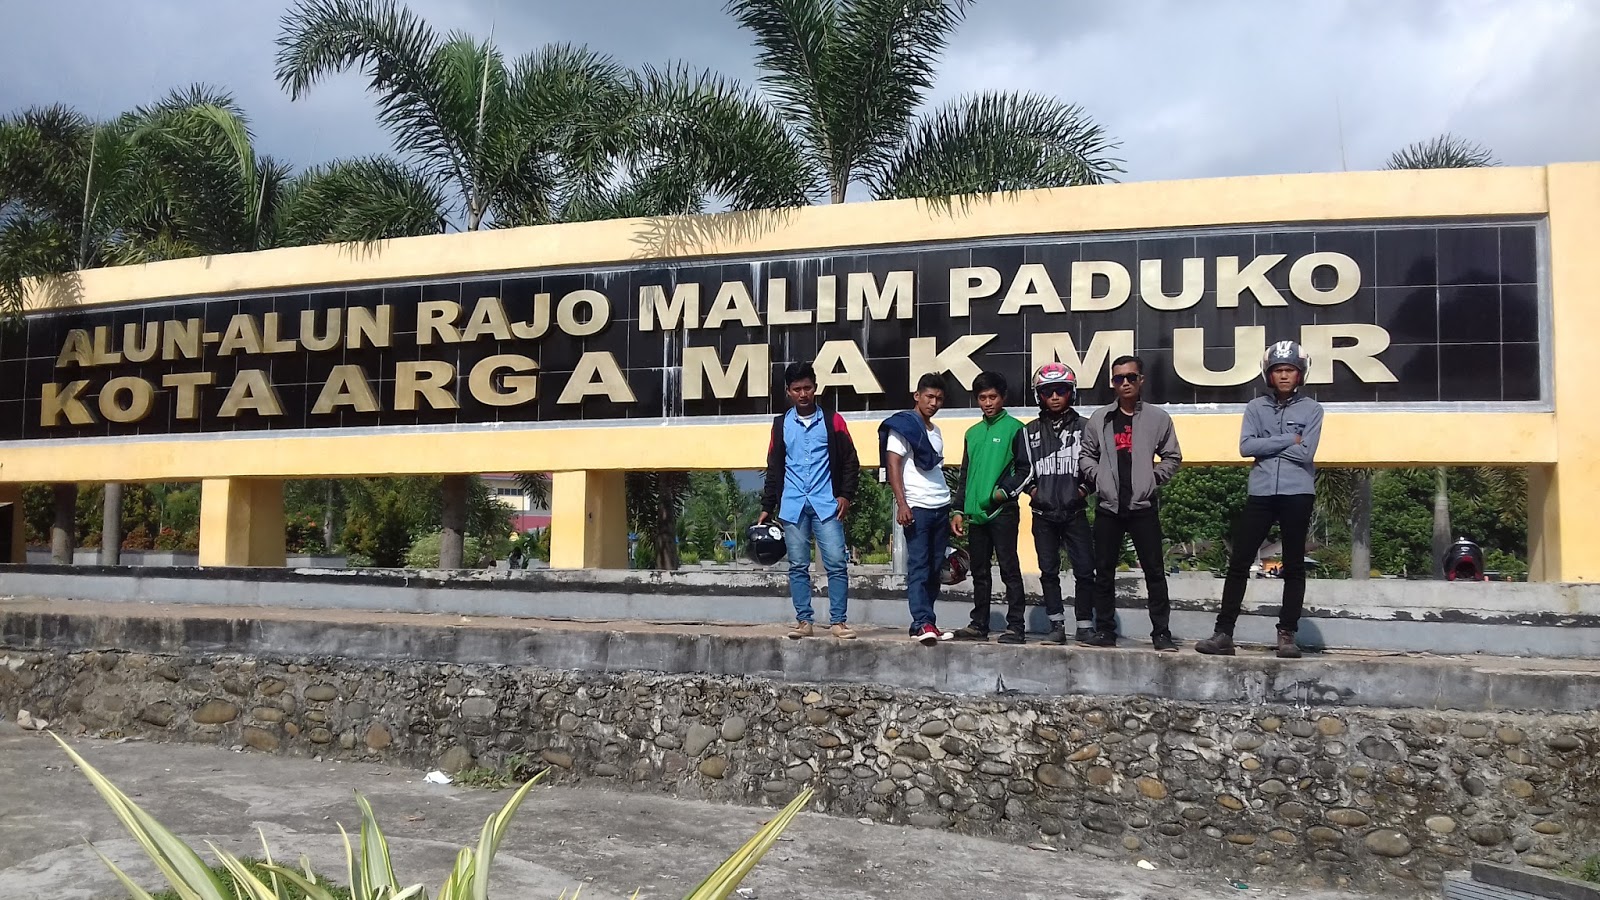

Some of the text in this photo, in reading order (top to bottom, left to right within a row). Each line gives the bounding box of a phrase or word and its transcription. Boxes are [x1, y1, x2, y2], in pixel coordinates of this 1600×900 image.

[57, 251, 1362, 368] ALUN-ALUN RAJO MALIM PADUKO
[40, 323, 1399, 427] KOTA ARGA MAKMUR
